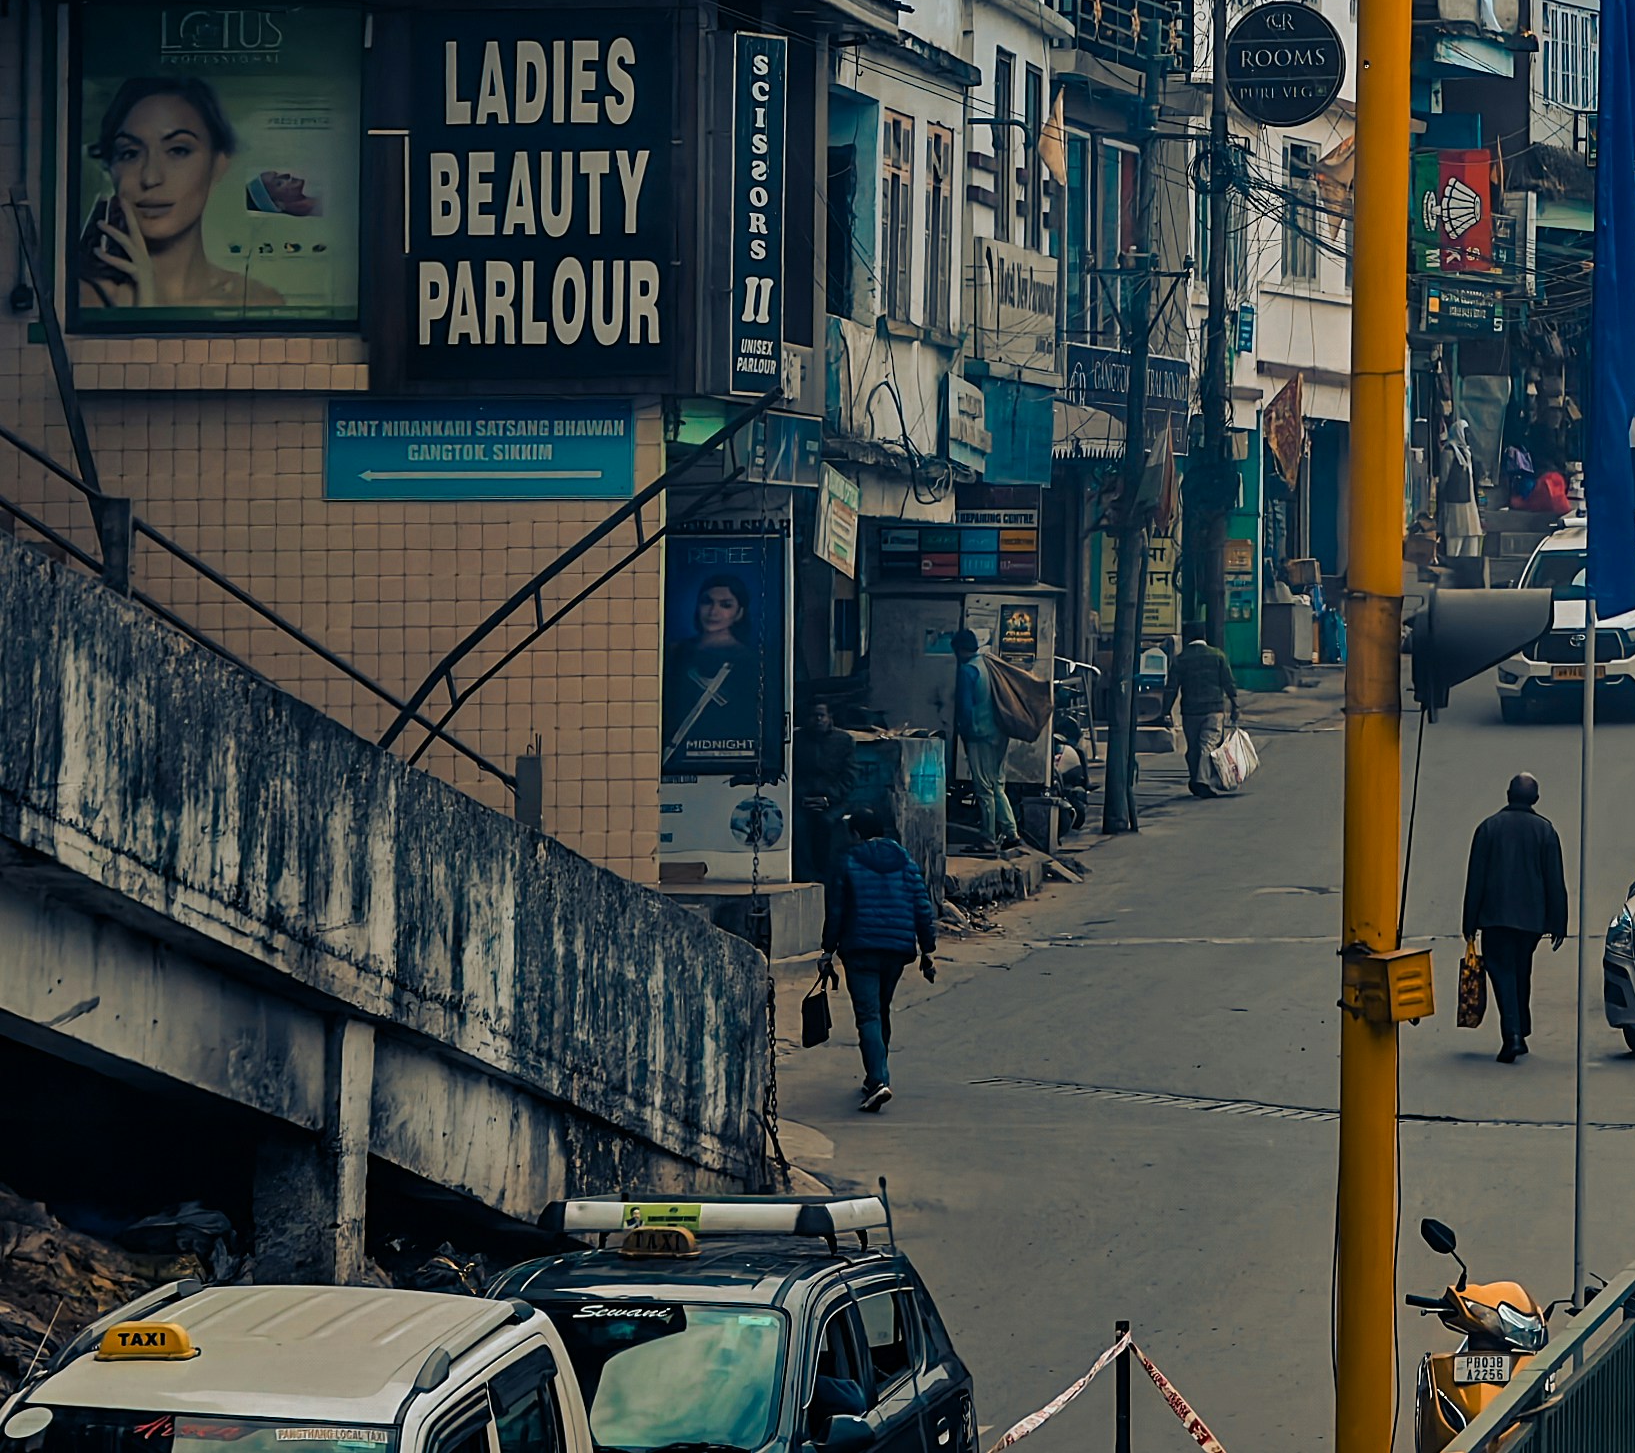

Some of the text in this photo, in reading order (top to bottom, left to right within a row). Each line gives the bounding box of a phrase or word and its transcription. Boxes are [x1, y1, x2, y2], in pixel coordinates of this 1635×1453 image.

[1241, 47, 1325, 68] ROOMS
[445, 37, 636, 125] LADIES
[748, 54, 771, 261] SCISSORS
[430, 150, 650, 237] BEAUTY
[419, 257, 660, 345] PARLOUR
[740, 338, 774, 356] UNISEX
[736, 356, 777, 376] PARLOUR
[336, 420, 379, 438] SANT
[475, 420, 550, 437] SATSANG
[553, 420, 624, 436] BHAWAN
[493, 444, 552, 460] SIKKIM
[686, 739, 755, 750] MIDNIGHT
[632, 1233, 681, 1251] TAXI
[117, 1332, 167, 1347] TAXI
